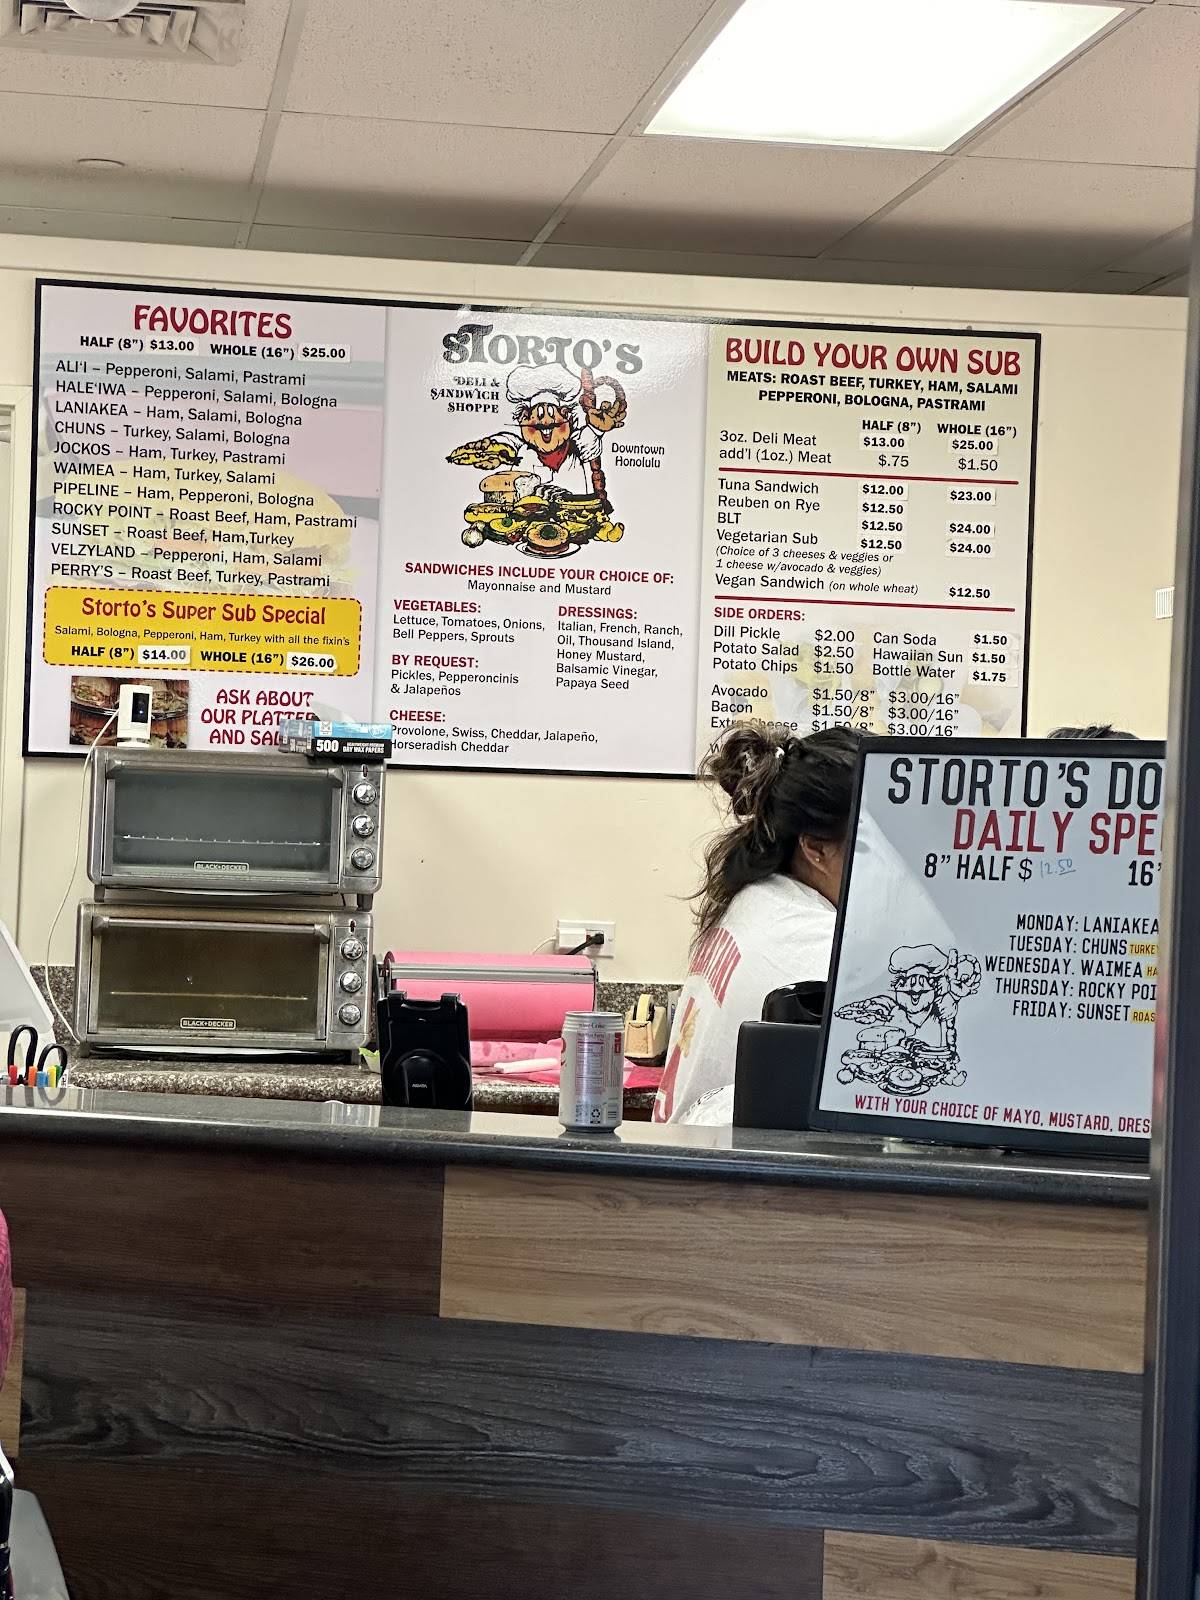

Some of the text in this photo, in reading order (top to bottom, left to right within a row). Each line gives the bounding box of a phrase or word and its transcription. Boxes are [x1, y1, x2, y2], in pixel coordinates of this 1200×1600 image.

[134, 305, 292, 339] FAVORITES
[80, 336, 346, 361] HALF (8”) $13.00 WHOLE (16”) $25.00
[442, 323, 643, 374] STORTO’S
[726, 338, 1021, 376] BUILD YOUR OWN SUB
[106, 362, 181, 380] Pepperoni,
[185, 367, 238, 384] Salami,
[243, 370, 306, 386] Pastrami
[453, 376, 500, 388] DELI &
[727, 370, 1018, 395] MEATS: ROAST BEEF, TURKEY, HAM, SALAMI
[430, 388, 499, 401] SANDWICH
[56, 400, 302, 428] LANIAKEA Ham, Salami, Bologna
[447, 402, 499, 414] SHOPPE
[862, 420, 921, 435] HALF (8”)
[937, 423, 1017, 439] WHOLE (16”)
[720, 430, 817, 446] 3oz. Deli Meat
[863, 436, 905, 448] $13.00
[952, 439, 993, 451] $25.00
[611, 442, 665, 455] Downtown
[615, 456, 660, 468] Honolulu
[53, 461, 275, 485] WAIMEA Ham, Turkey, Salami
[718, 478, 819, 494] Tuna Sandwich
[862, 484, 904, 495] $12.00
[950, 490, 991, 501] $23.00
[53, 502, 357, 528] ROCKY POINT Roast Beef, Ham, Pastrami
[718, 512, 742, 524] BLT
[862, 520, 903, 532] $12.50
[949, 522, 991, 535] $24.00
[716, 528, 818, 545] Vegetarian Sub
[860, 538, 902, 550] $12.50
[716, 545, 755, 557] (Choice
[758, 547, 770, 557] of
[772, 547, 780, 557] 3
[783, 549, 825, 560] cheeses
[828, 550, 837, 560] &
[841, 552, 879, 563] veggies
[950, 542, 991, 554] $24.00
[405, 562, 674, 584] SANDWICHES INCLUDE YOUR CHOICE OF:
[716, 558, 881, 578] 1 cheese w/avocado & veggies)
[715, 573, 918, 596] Vegan Sandwich (on whole wheat)
[949, 586, 990, 599] $12.50
[82, 597, 325, 625] Storto’s Super Sub Special
[394, 599, 481, 613] VEGETABLES:
[558, 606, 637, 620] DRESSINGS:
[714, 606, 805, 621] SIDE ORDERS:
[393, 614, 545, 631] Lettuce, Tomatoes, Onions,
[558, 620, 683, 637] Italian, French, Ranch,
[55, 625, 350, 646] Salami, Bologna, Pepperoni, Ham, Turkey with all the fixin’s
[393, 628, 515, 644] Bell Peppers, Sprouts
[714, 625, 855, 642] Dill Pickle $2.00
[873, 632, 936, 646] Can Soda
[974, 633, 1007, 645] $1.50
[71, 645, 334, 668] HALF (8”) $14.00 WHOLE (16”) $26.00
[972, 652, 1006, 664] $1.50
[972, 670, 1006, 682] $1.75
[216, 689, 314, 707] ASK ABOUT
[389, 710, 445, 722] CHEESE:
[711, 700, 959, 723] Bacon $1.50/8” $3.00/16”
[316, 740, 339, 753] 500
[888, 757, 1090, 809] STORTO’S
[953, 808, 1074, 853] DAILY
[1016, 914, 1159, 935] MONDAY: LANIAKEA
[1009, 935, 1127, 955] TUESDAY: CHUNS
[995, 977, 1126, 999] THURSDAY: ROCKY
[1013, 1000, 1131, 1021] FRIDAY: SUNSET
[855, 1094, 890, 1112] WITH
[895, 1098, 927, 1115] YOUR
[931, 1101, 979, 1119] CHOICE
[983, 1106, 999, 1121] OF
